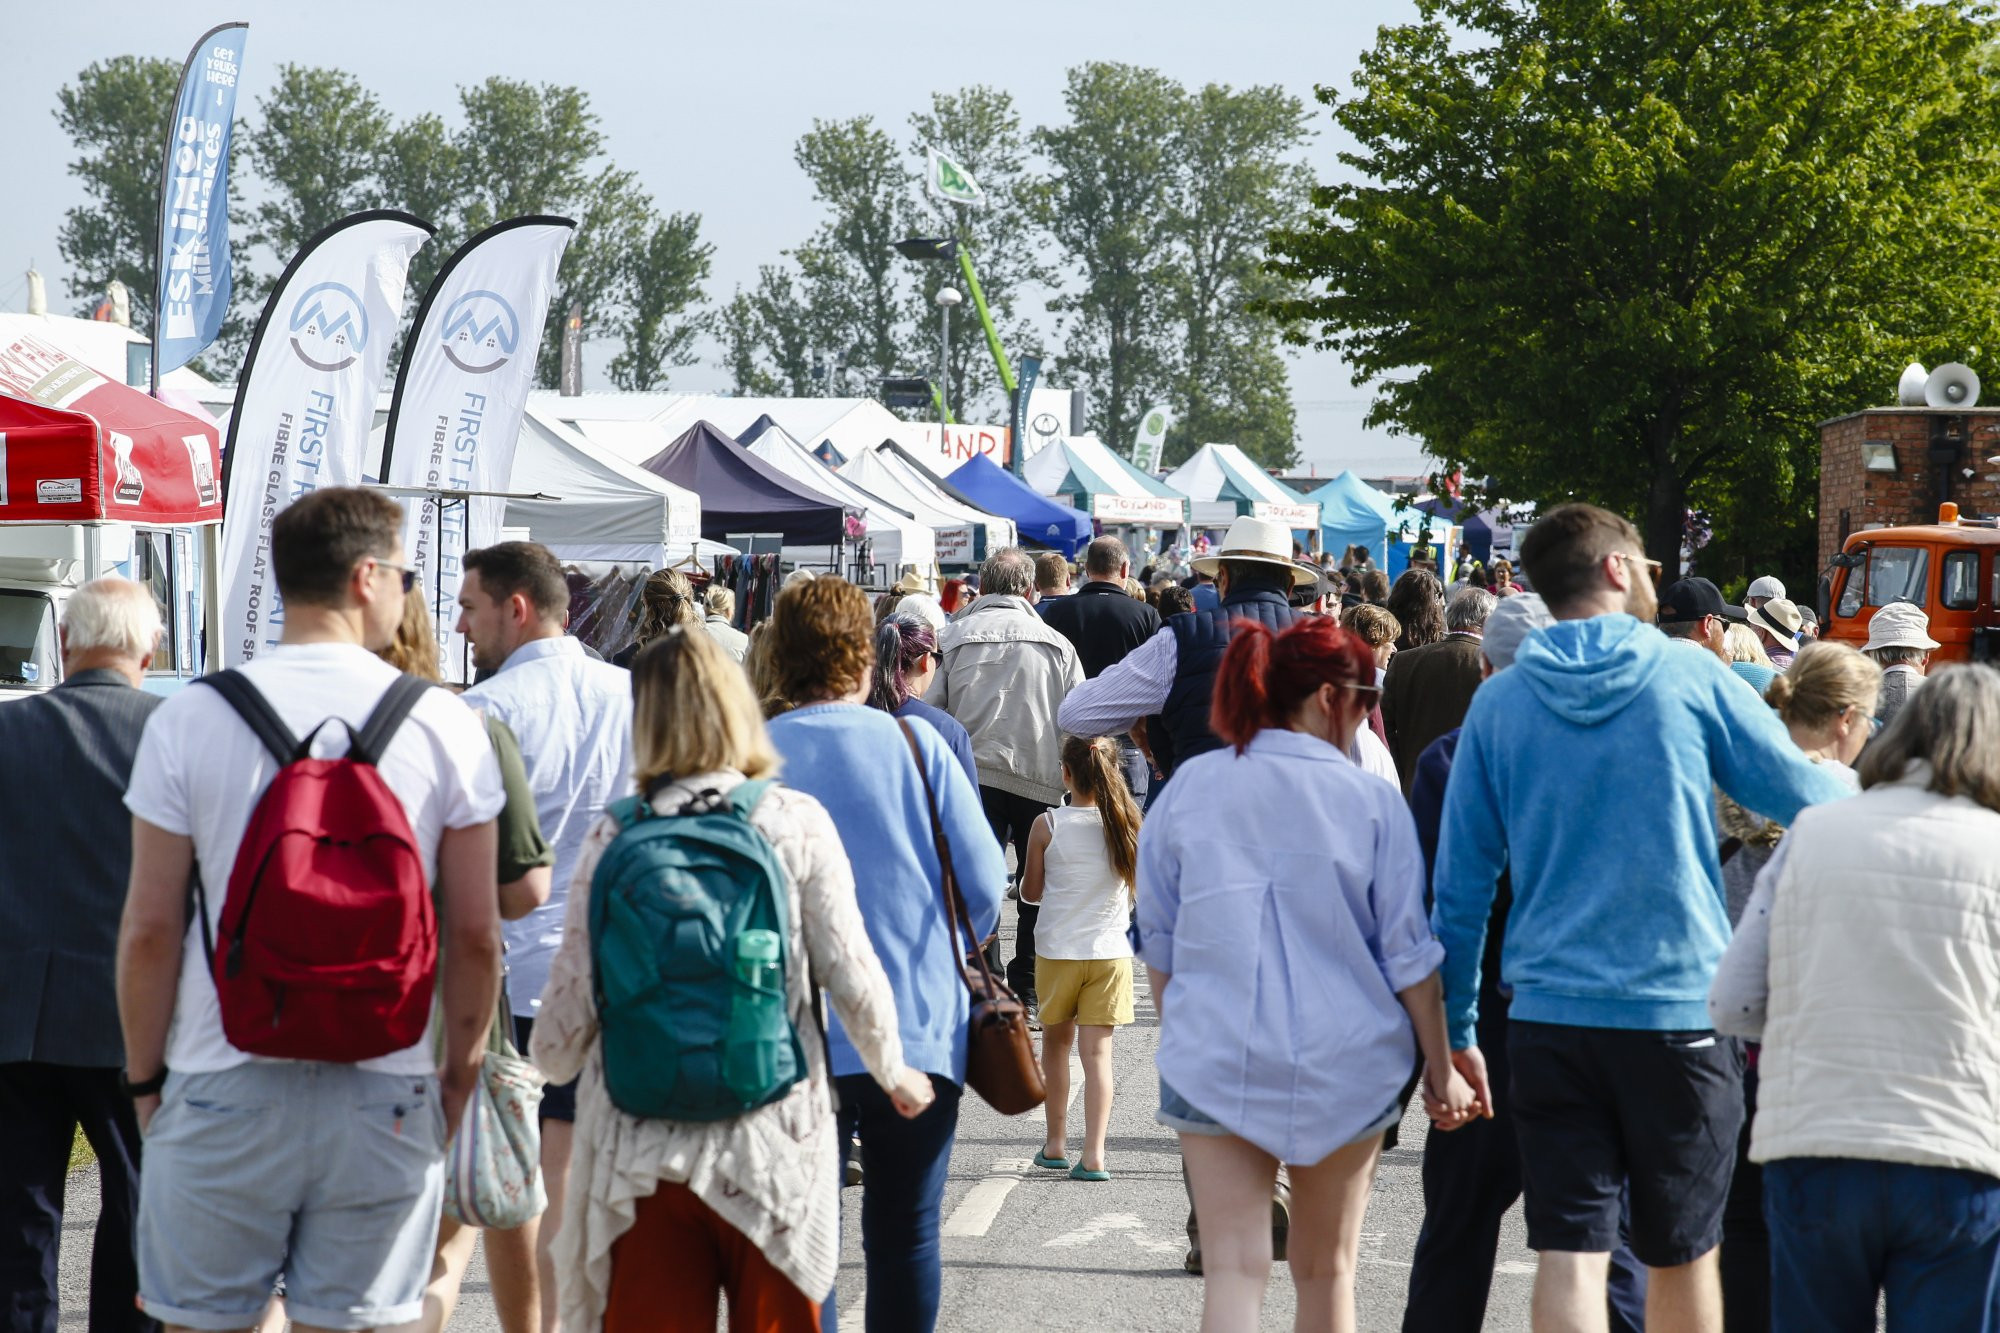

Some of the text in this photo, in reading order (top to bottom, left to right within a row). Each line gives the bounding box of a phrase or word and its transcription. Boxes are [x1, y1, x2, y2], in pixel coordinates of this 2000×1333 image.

[206, 57, 237, 76] YOURS
[213, 46, 235, 61] Get
[296, 389, 335, 475] FIRST
[430, 414, 449, 465] FIBRE
[451, 391, 487, 472] FIRST
[1112, 499, 1167, 511] TOYLAND
[241, 411, 294, 664] FIBRE GLASS FLAT ROOF SP
[414, 530, 430, 572] FLAT
